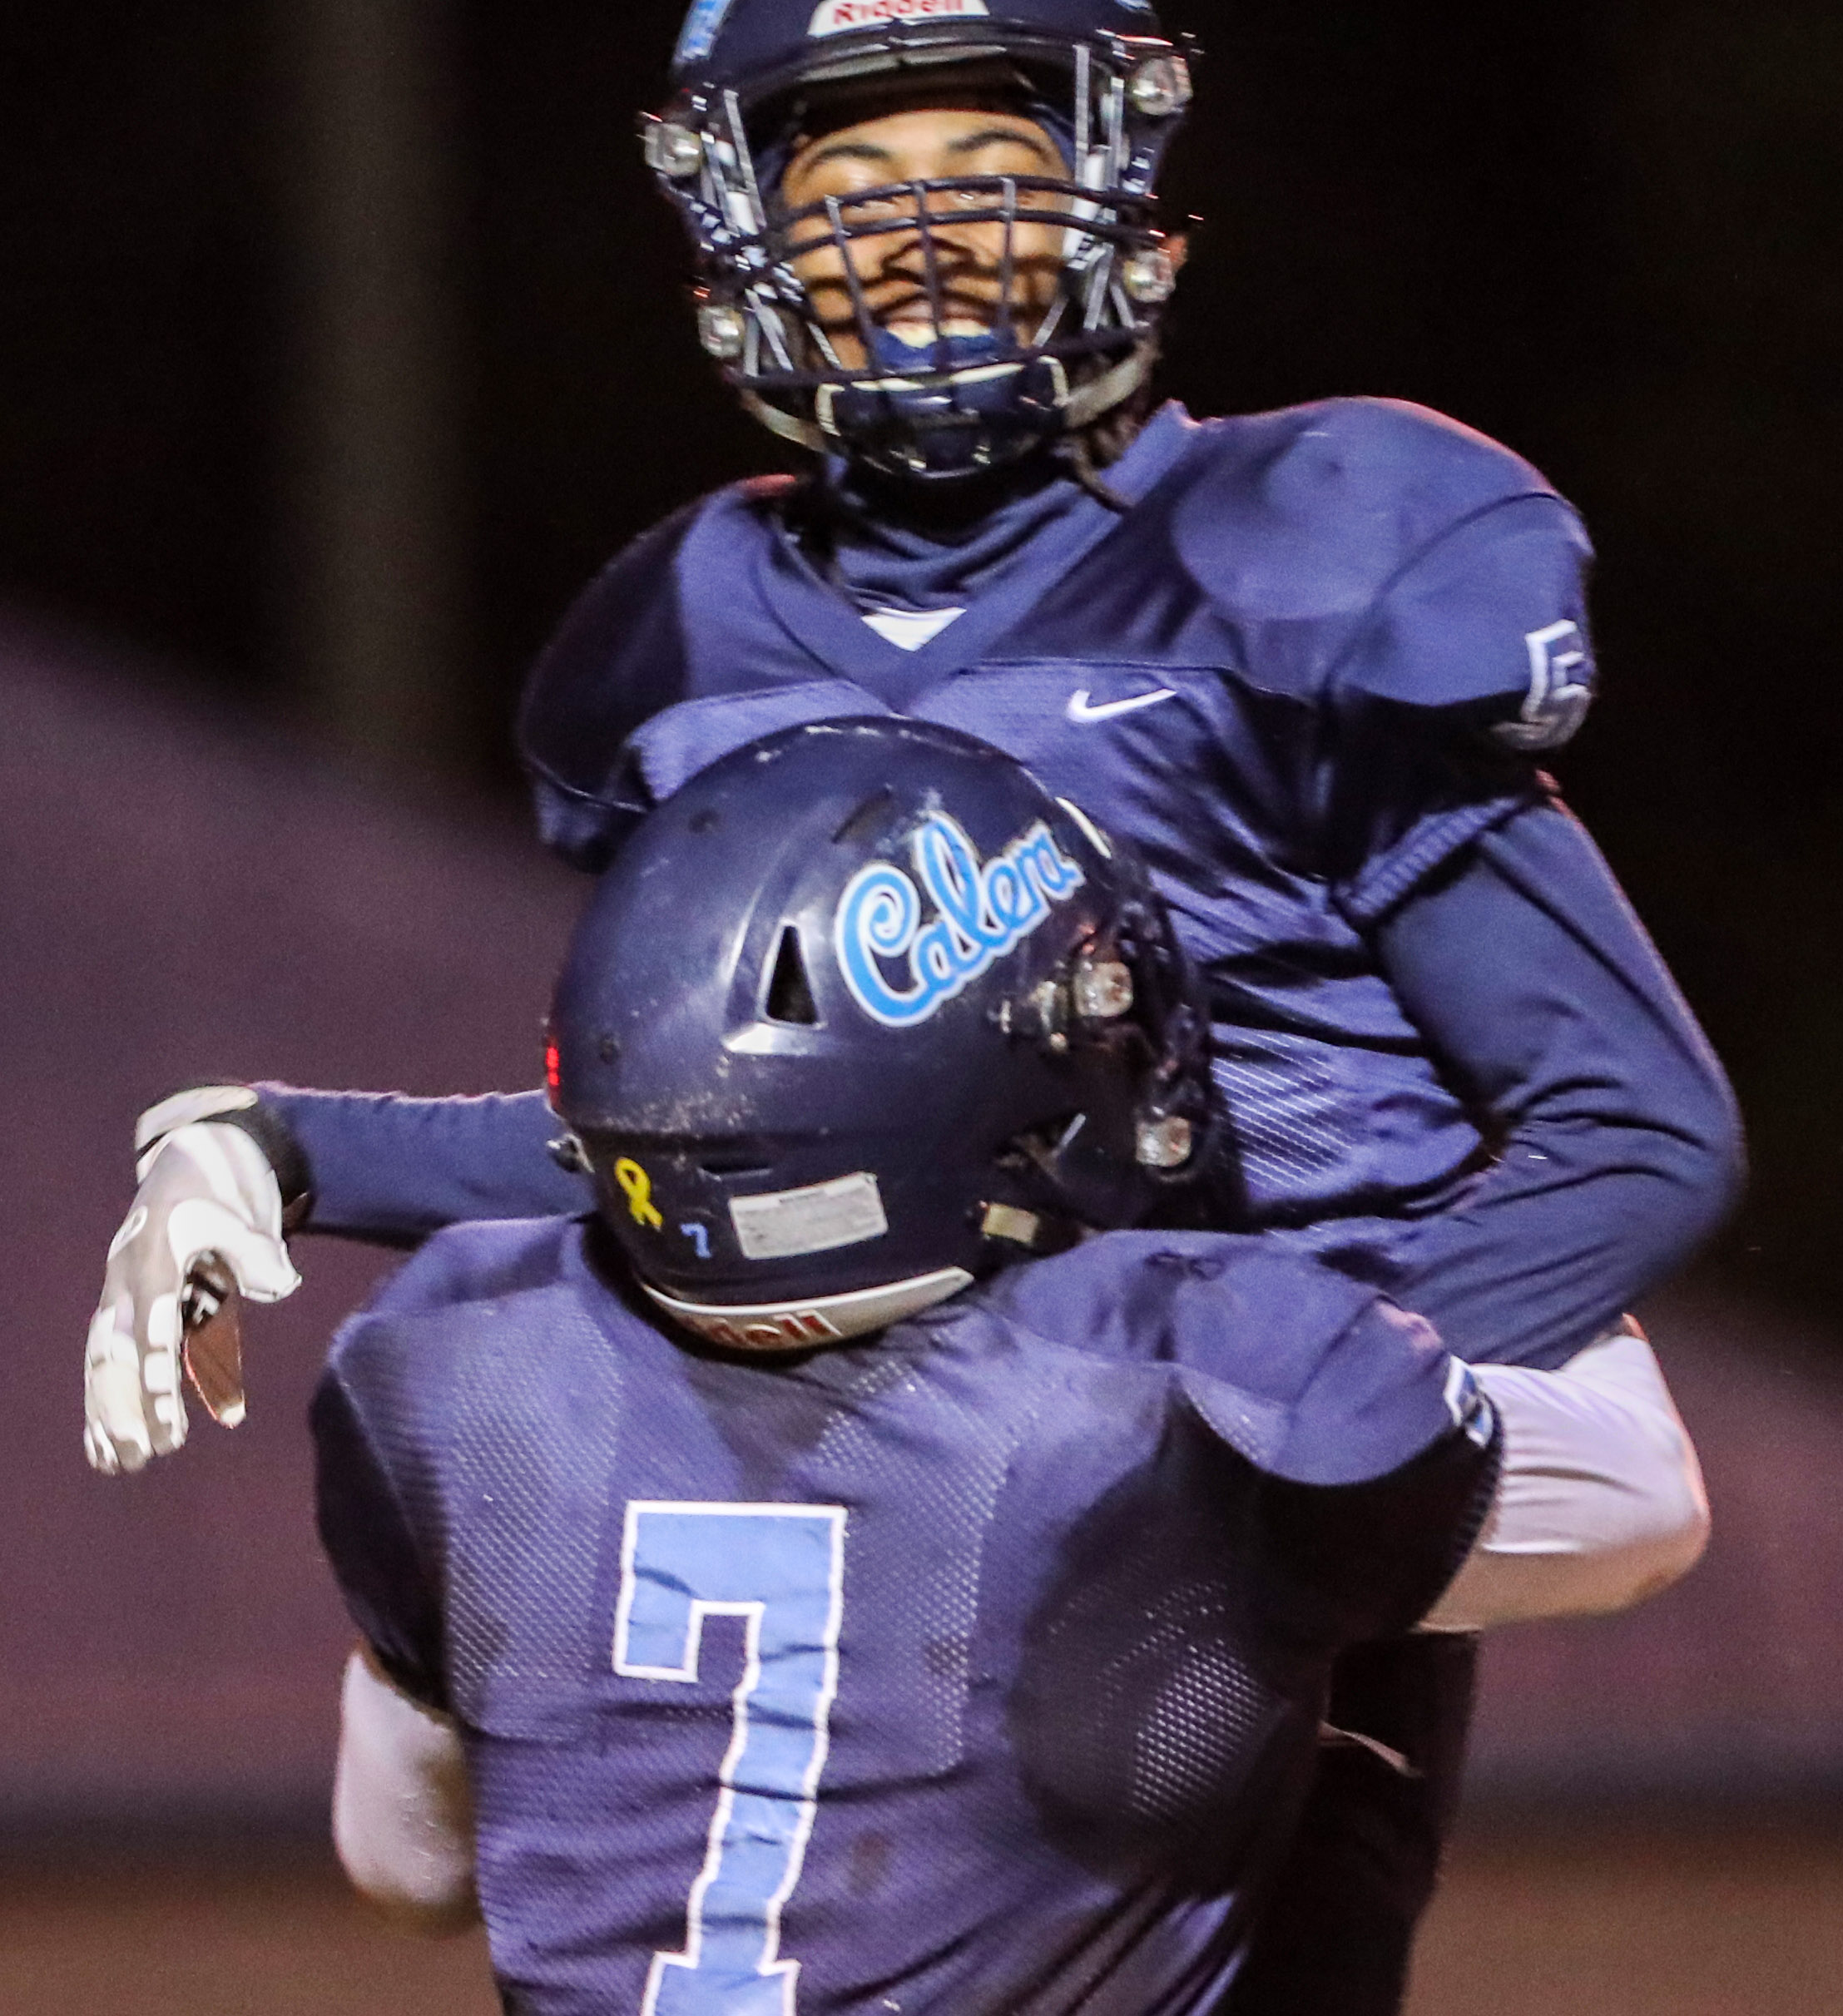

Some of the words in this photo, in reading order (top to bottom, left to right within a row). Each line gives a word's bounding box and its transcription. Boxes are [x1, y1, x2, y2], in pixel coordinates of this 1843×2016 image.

[835, 810, 1087, 1027] Calera
[679, 1221, 712, 1259] 7
[612, 1499, 848, 2016] 7
